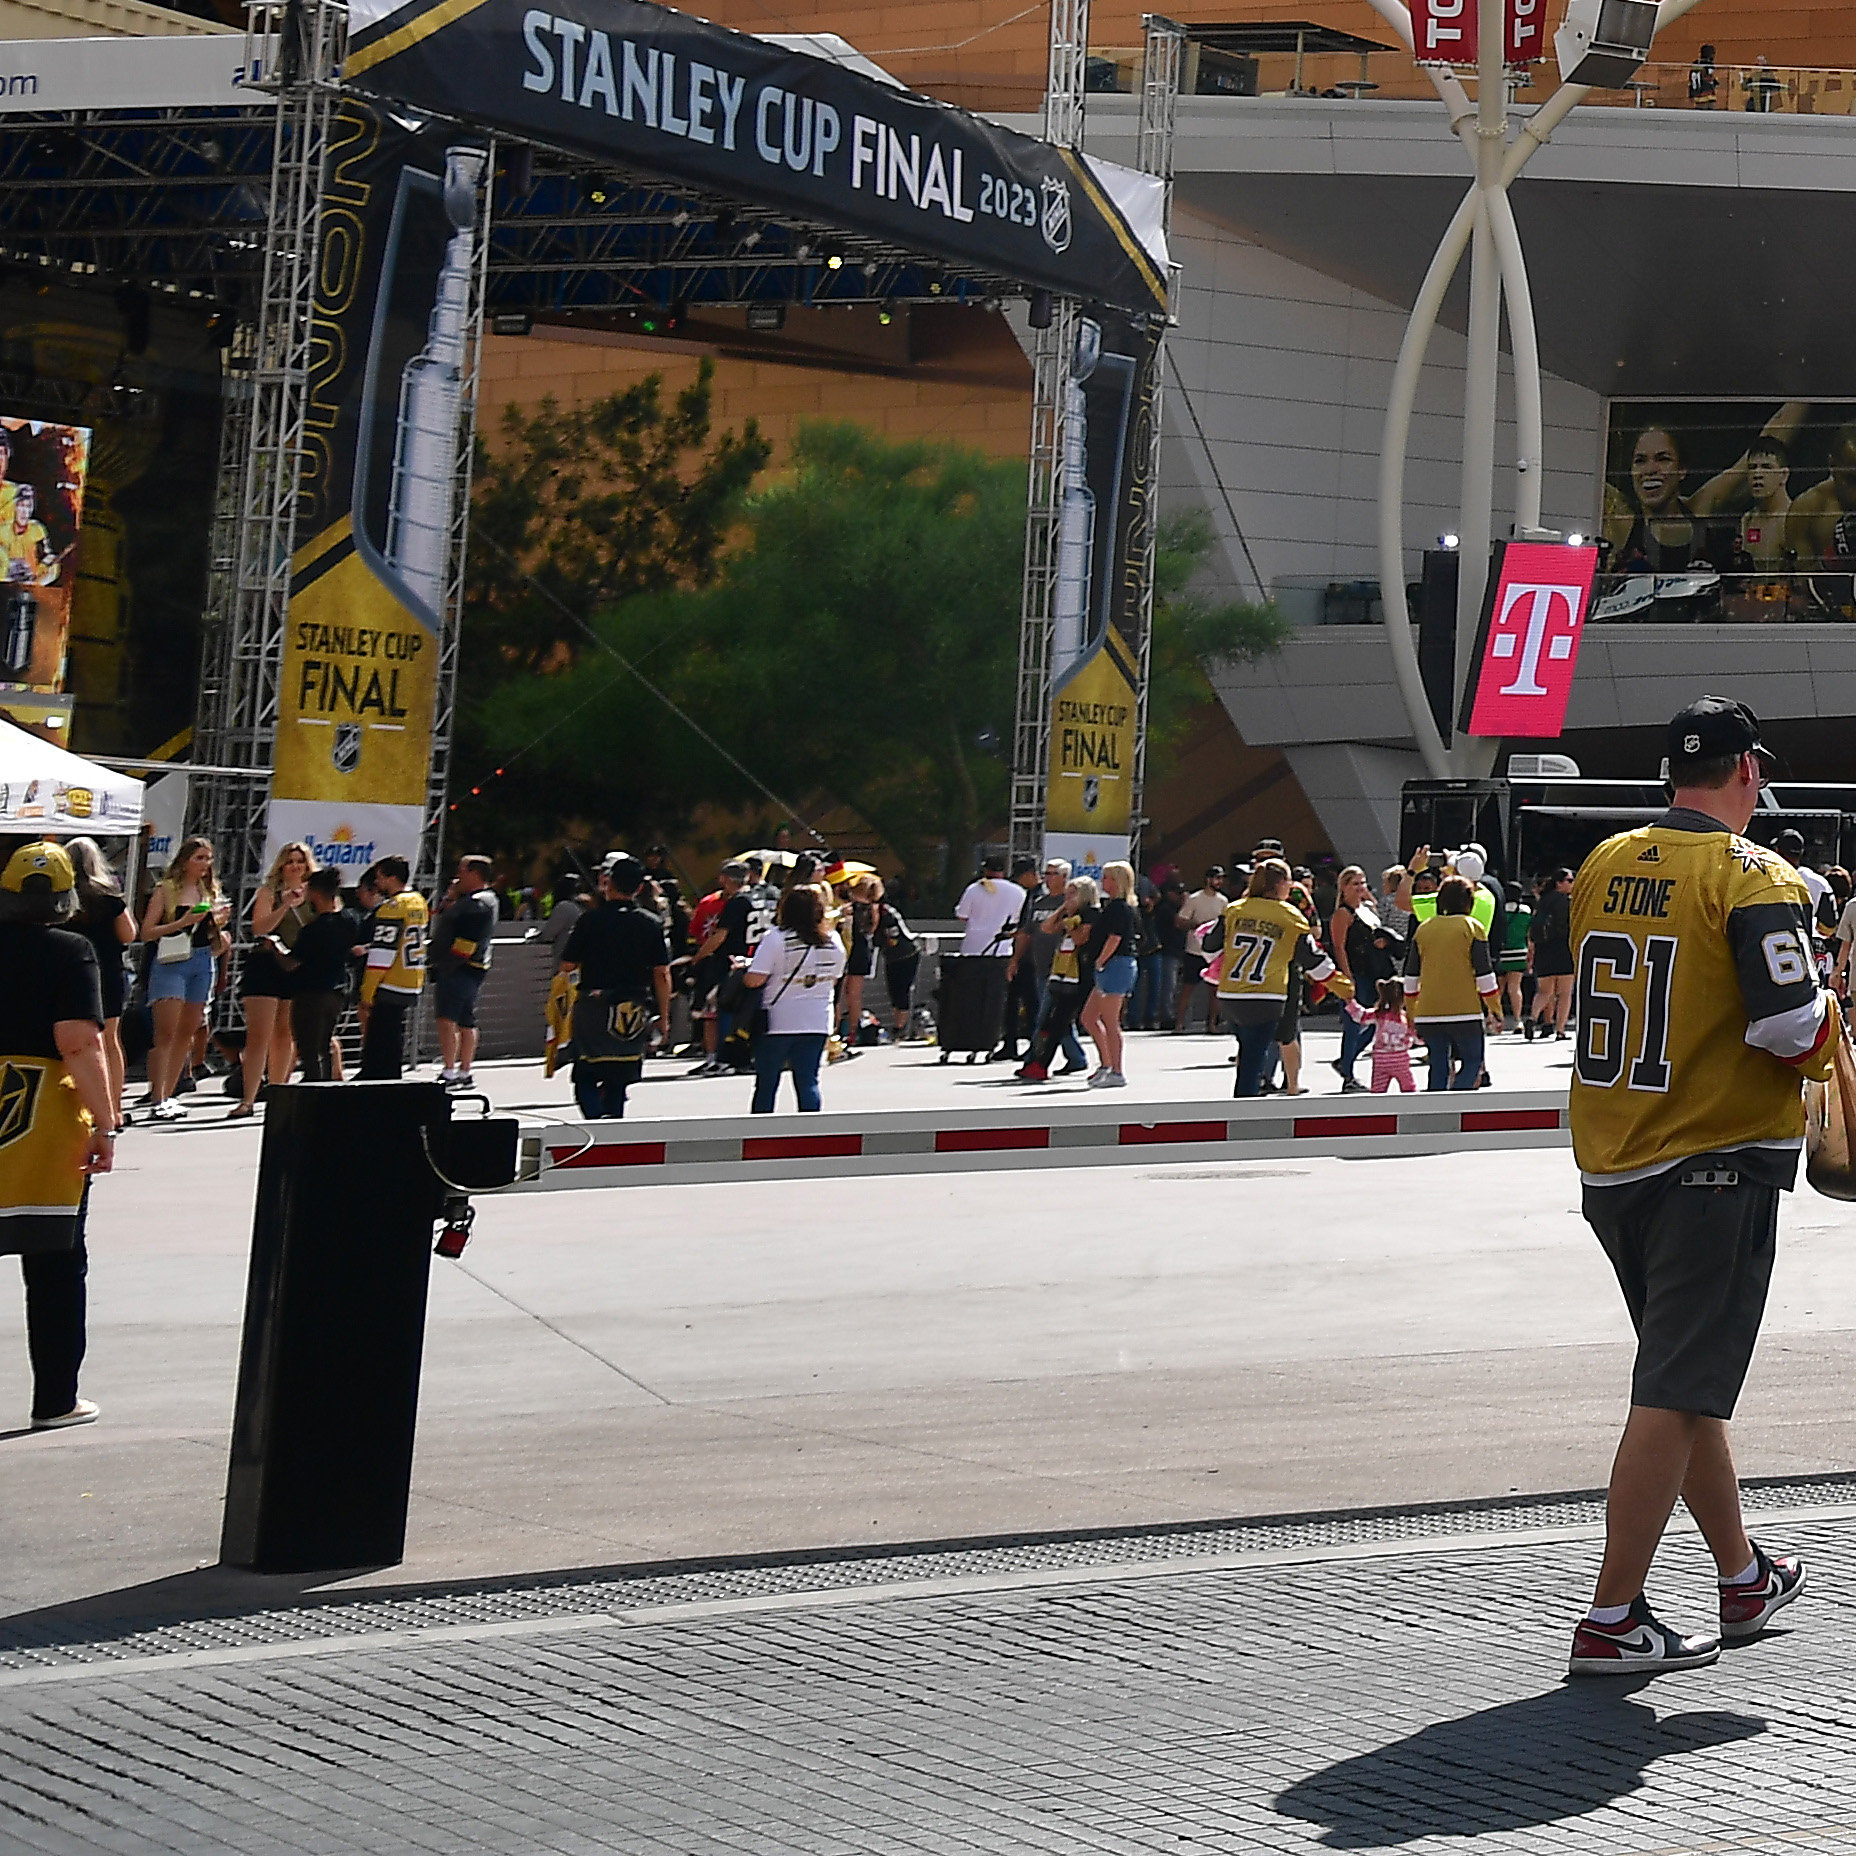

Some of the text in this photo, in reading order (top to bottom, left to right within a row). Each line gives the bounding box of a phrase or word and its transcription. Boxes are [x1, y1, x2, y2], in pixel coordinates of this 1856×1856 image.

[521, 7, 1038, 229] STANLEY CUP FINAL 2023
[296, 622, 422, 662] STANLEY CUP
[299, 659, 408, 717] FINAL
[1058, 699, 1129, 728] STANLEY CUP
[1061, 728, 1121, 771] FINAL
[1603, 875, 1676, 918] STONE
[373, 925, 399, 944] 23
[1228, 932, 1275, 985] 71
[1576, 930, 1679, 1093] 61
